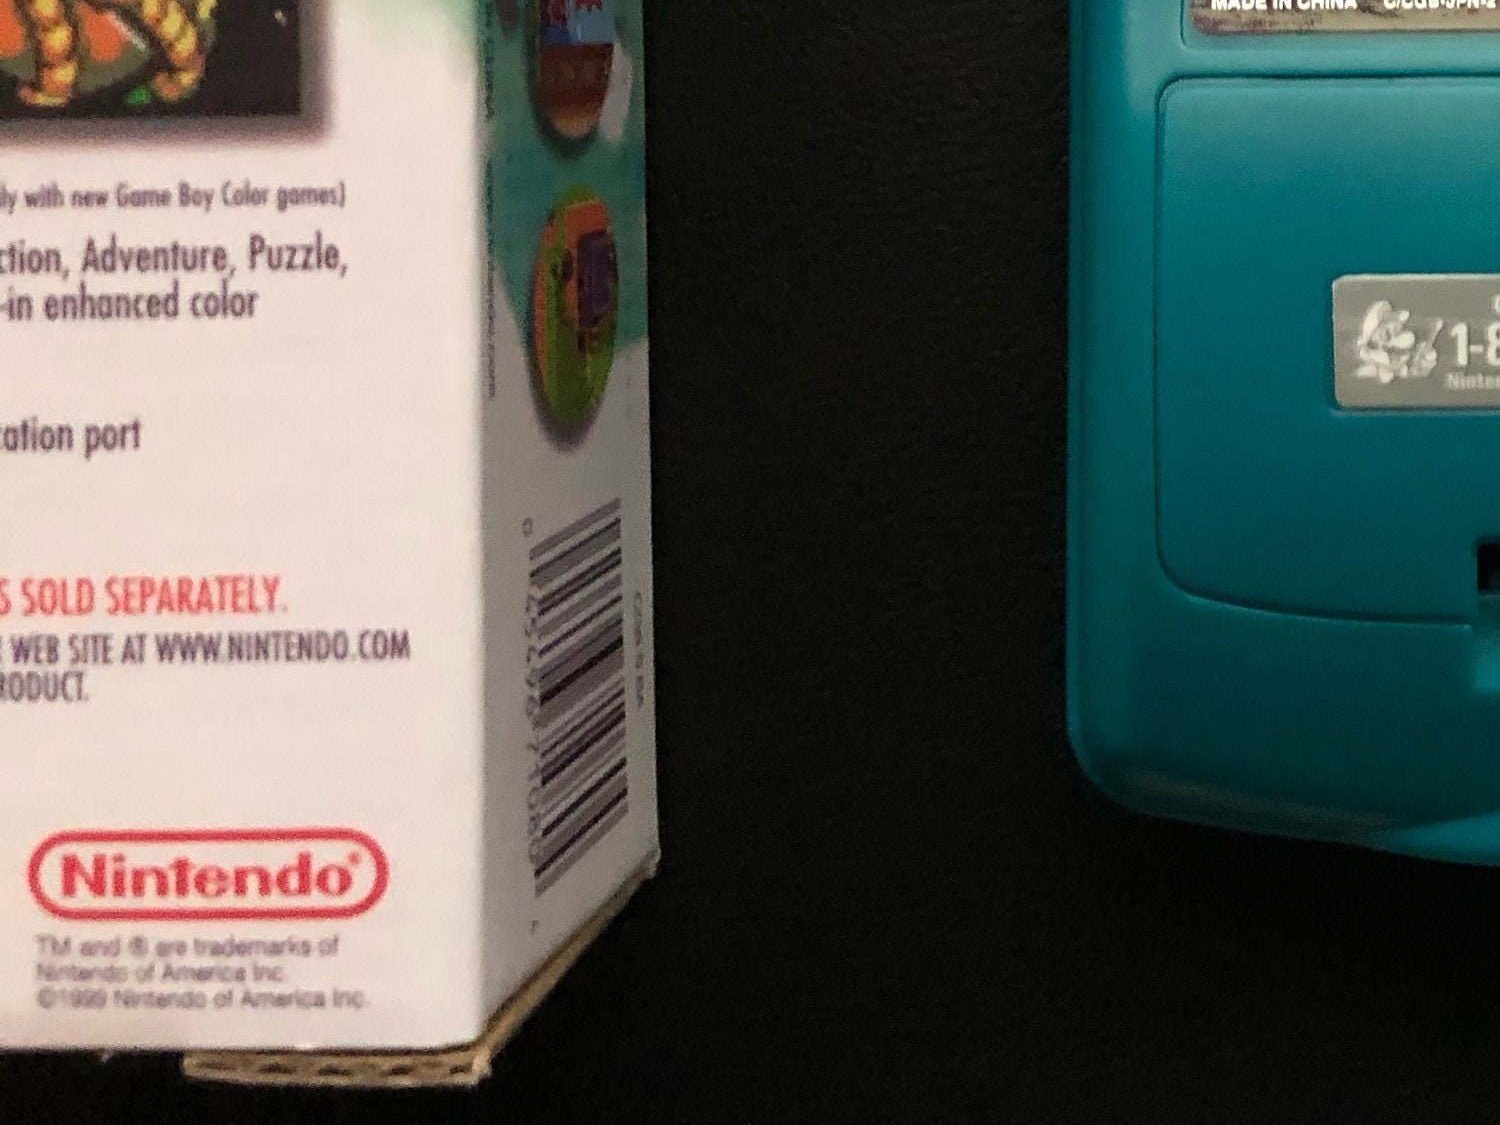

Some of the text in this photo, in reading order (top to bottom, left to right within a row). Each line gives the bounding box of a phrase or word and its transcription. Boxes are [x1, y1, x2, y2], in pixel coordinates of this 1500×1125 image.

[24, 181, 65, 208] with
[71, 189, 109, 208] new
[116, 181, 173, 208] Game
[179, 180, 215, 213] Boy
[221, 179, 268, 207] Color
[277, 180, 346, 212] games)
[81, 231, 237, 280] Adventure,
[249, 229, 349, 278] Puzzle,
[44, 276, 180, 322] enhanced
[190, 276, 260, 319] color
[0, 416, 140, 461] ation port
[21, 575, 95, 615] SOLD
[104, 574, 288, 615] SEPARATELY.
[10, 628, 411, 664] WEB SITE AT WWW.NINTENDO.COM
[36, 934, 72, 956] TM
[80, 936, 121, 957] and
[155, 939, 188, 957] are
[193, 934, 312, 957] trademarks
[318, 933, 340, 957] of
[36, 963, 128, 982] Nintendo
[136, 962, 156, 982] of
[160, 961, 247, 982] America
[113, 987, 207, 1009] Nintendo
[213, 987, 234, 1009] of
[241, 987, 327, 1008] America
